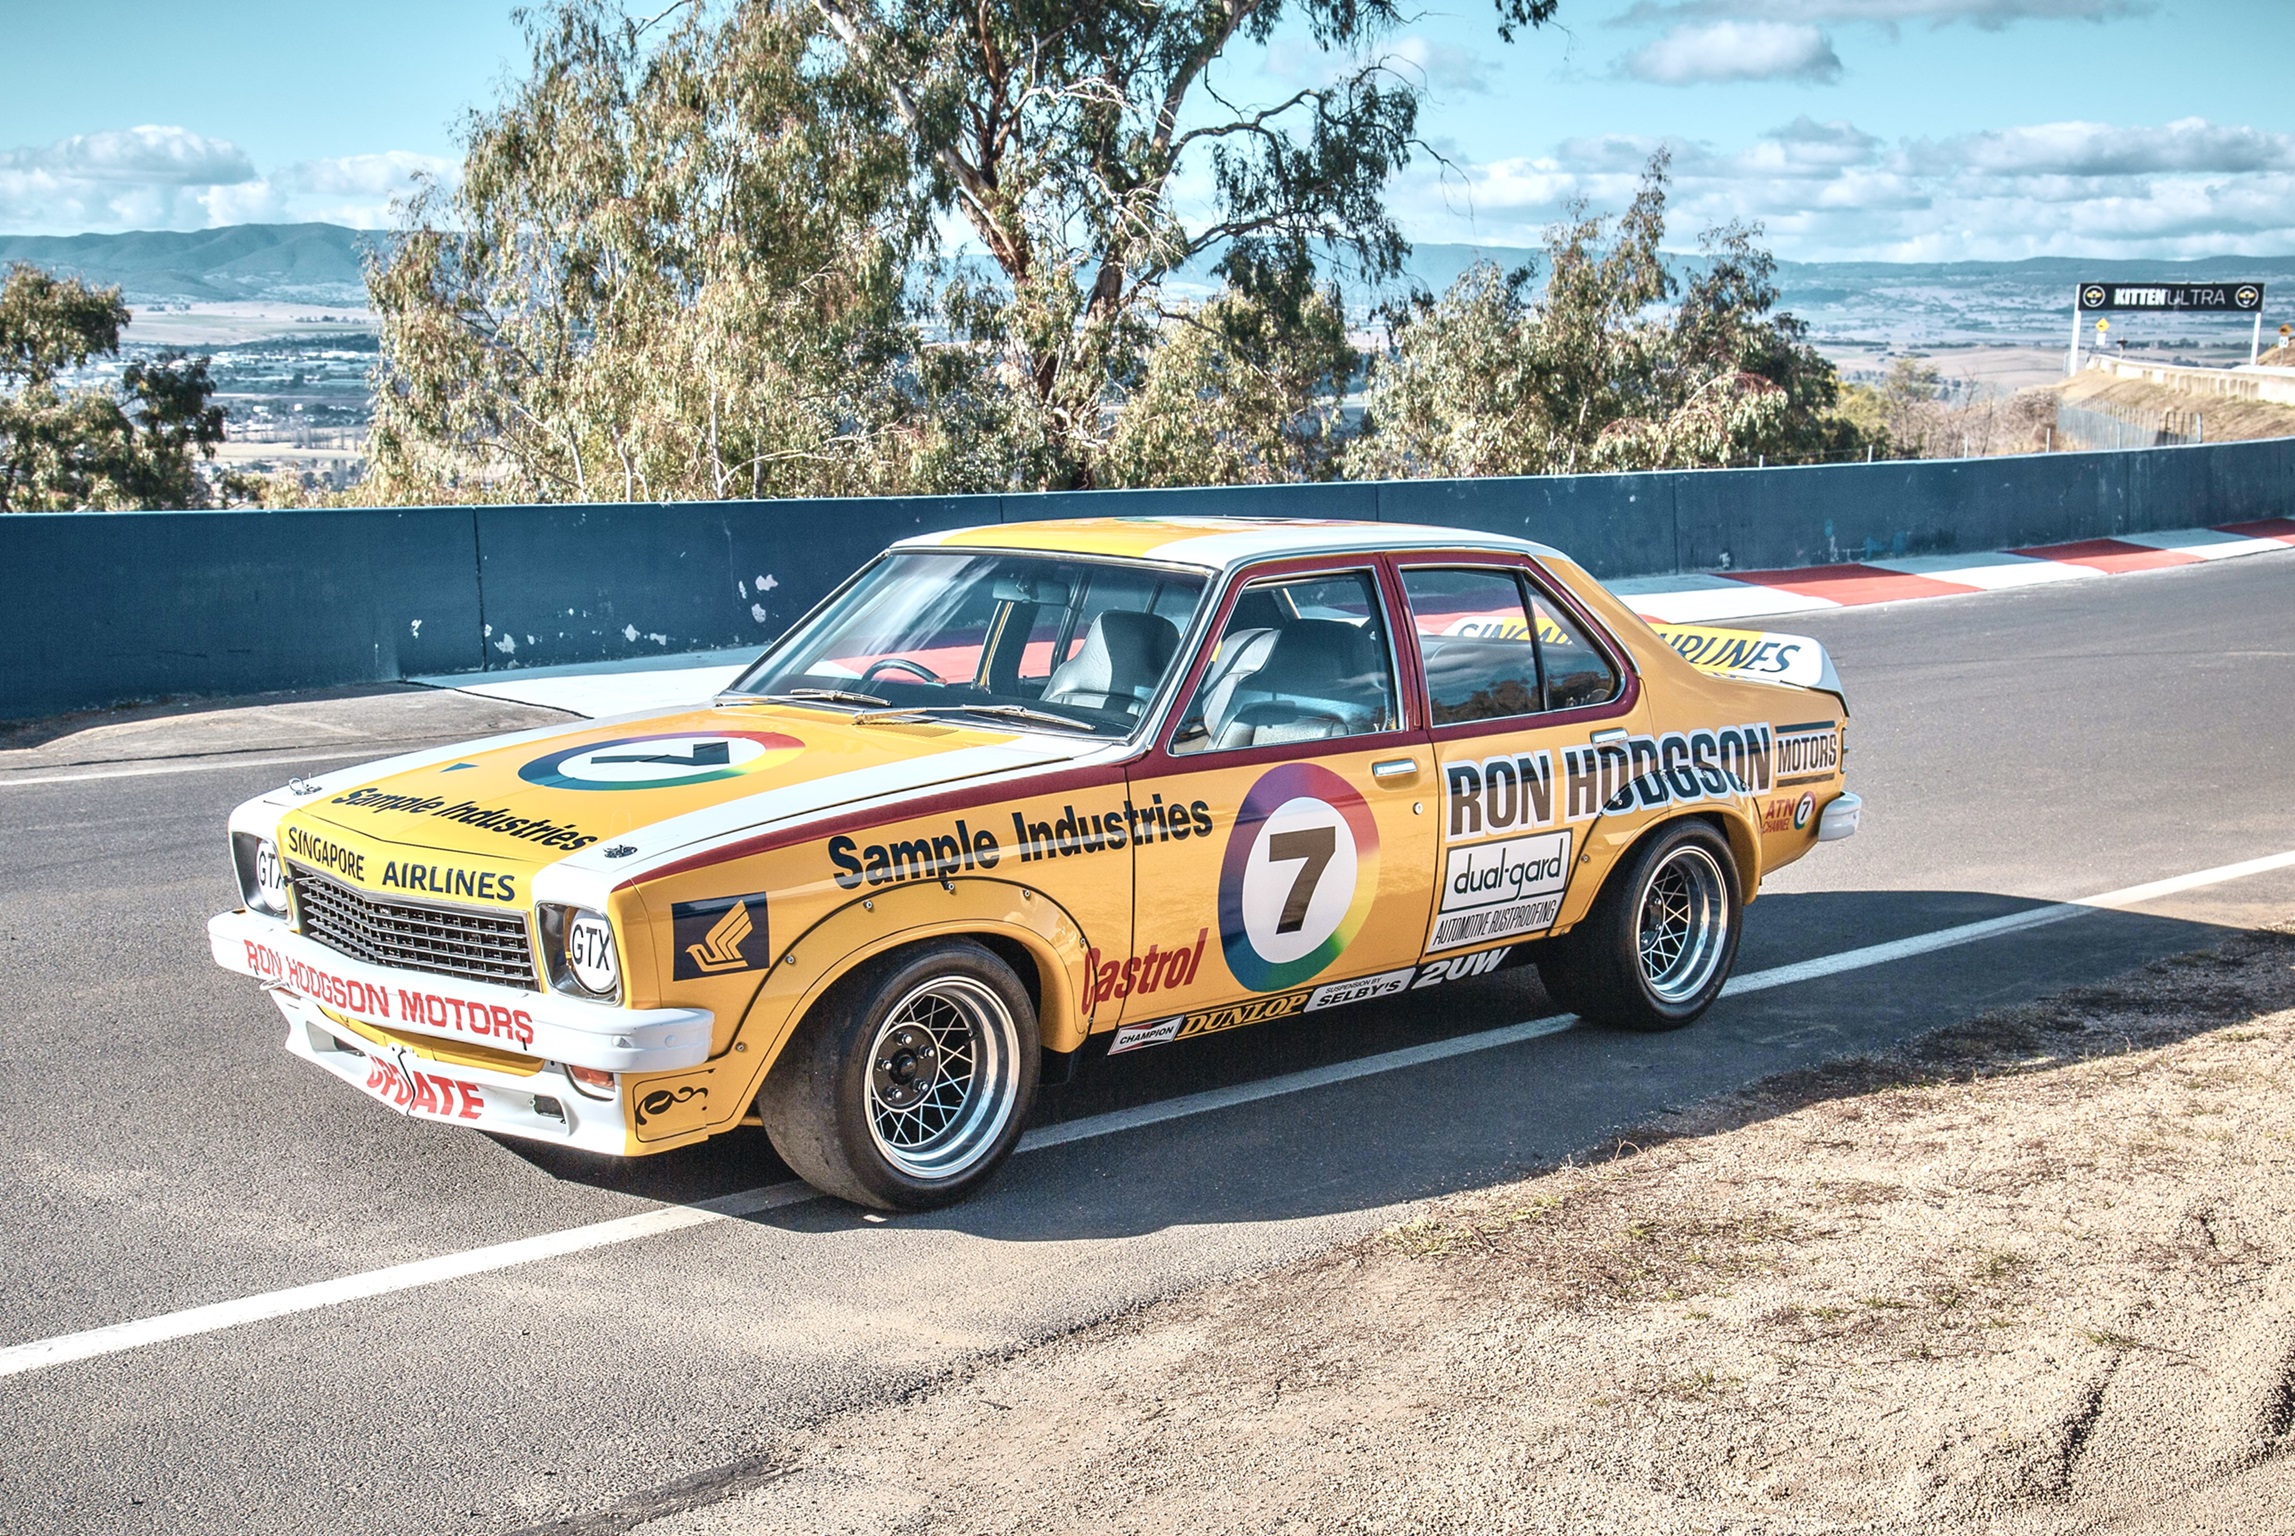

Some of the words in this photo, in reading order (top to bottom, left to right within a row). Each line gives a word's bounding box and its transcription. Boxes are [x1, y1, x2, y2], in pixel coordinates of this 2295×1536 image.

[590, 741, 730, 767] 7
[1445, 752, 1552, 838] RON
[1563, 724, 1769, 818] HODGSON
[1776, 734, 1837, 773] MOTORS
[333, 787, 441, 817] Sample
[433, 799, 600, 852] Industries
[1762, 818, 1790, 834] CHANNEL
[1765, 798, 1796, 819] ATN
[1800, 800, 1811, 821] 7
[288, 826, 365, 883] SINGAPORE
[381, 861, 516, 903] AIRLINES
[827, 819, 1000, 891] Sample
[1010, 793, 1213, 863] Industries
[1268, 825, 1337, 935] 7
[1453, 837, 1564, 900] dual-gard
[1432, 911, 1492, 946] AUTOMOTIVE
[1488, 899, 1557, 935] RUSTPROOFING
[571, 922, 610, 973] GTX
[1080, 928, 1209, 1016] Castrol
[1411, 946, 1513, 990] 2UW
[243, 939, 282, 983] RON
[288, 955, 391, 1018] HODGSON
[398, 988, 534, 1045] MOTORS
[1316, 979, 1403, 1007] SELBY'S
[1324, 978, 1370, 994] SUSPENSION
[1370, 976, 1383, 986] BY
[1119, 1025, 1175, 1045] CHAMPION
[1178, 993, 1309, 1037] DUNLOP
[366, 1054, 485, 1119] UPDATE
